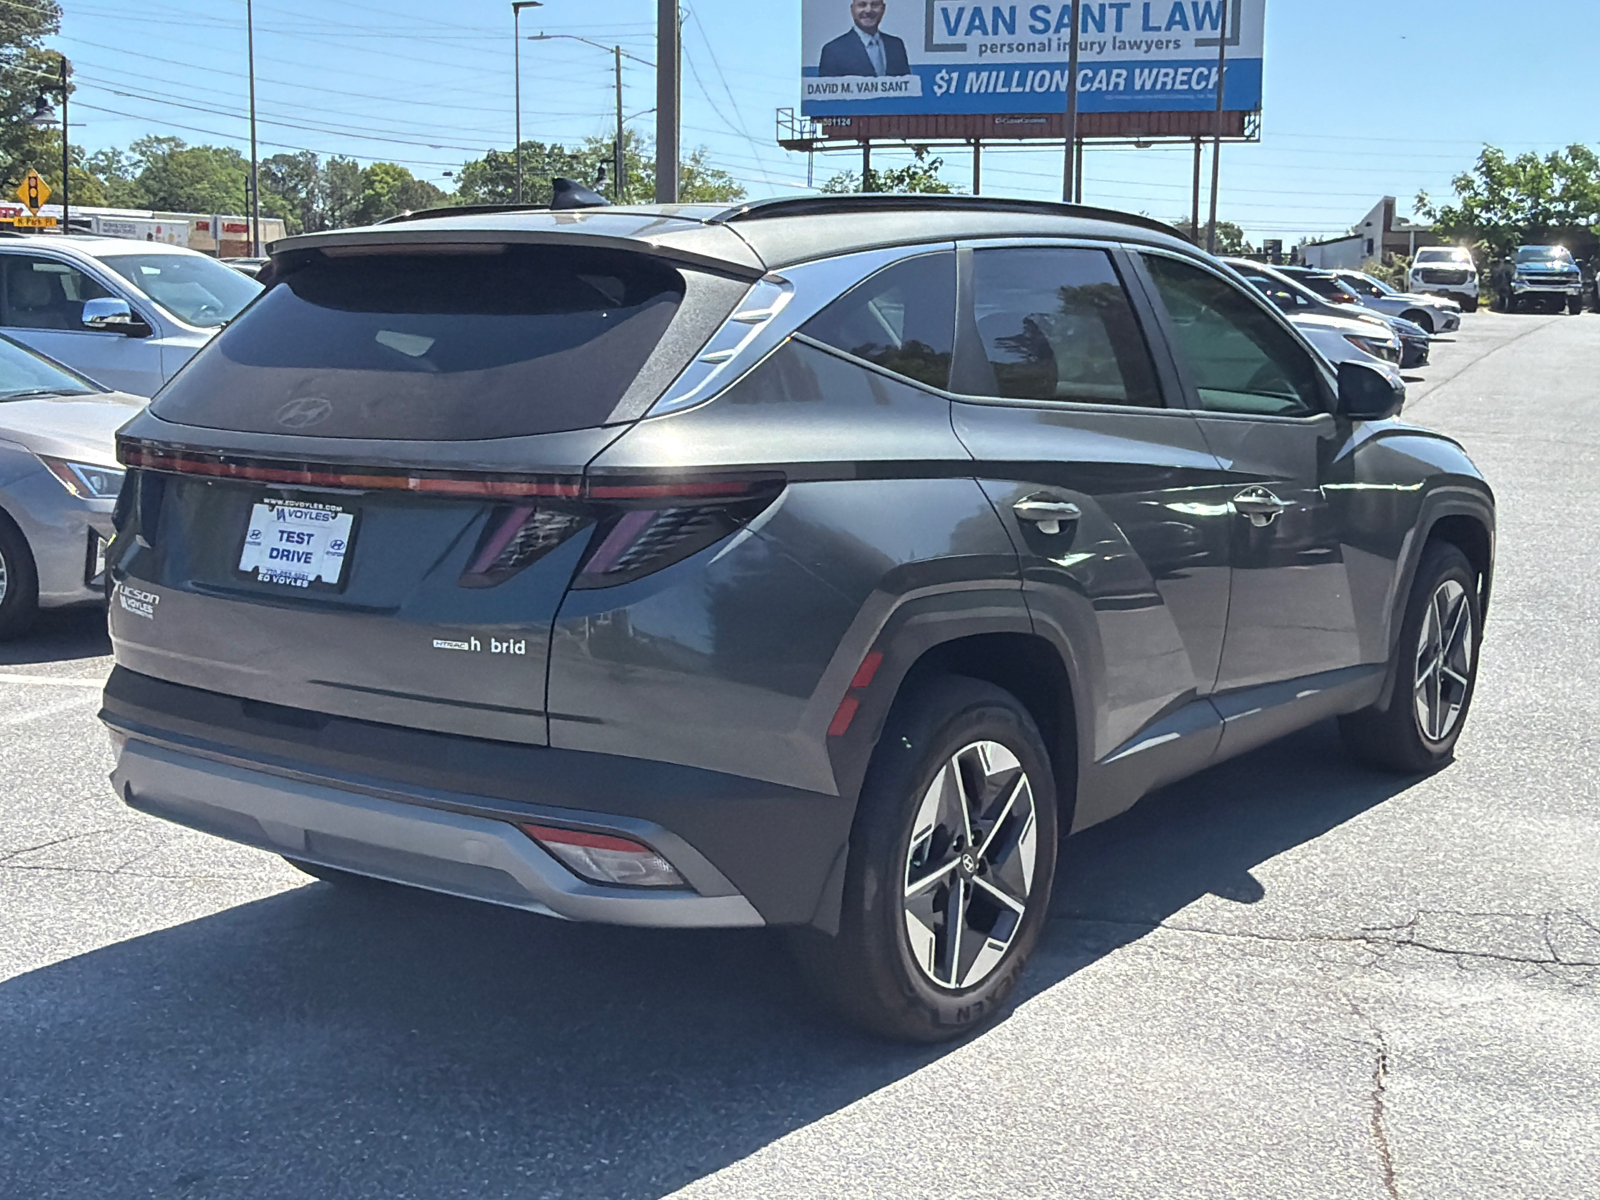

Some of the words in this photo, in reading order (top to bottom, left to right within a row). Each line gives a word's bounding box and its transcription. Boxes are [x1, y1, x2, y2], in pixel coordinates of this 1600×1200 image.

[940, 5, 1017, 37] VAN
[1028, 2, 1131, 35] SANT
[1141, 1, 1224, 32] LAW
[978, 37, 1051, 57] personal
[1057, 36, 1107, 55] inury
[1112, 36, 1181, 54] lawyers
[807, 83, 838, 94] DAVID
[841, 82, 853, 93] M.
[857, 82, 878, 93] VAN
[881, 80, 910, 92] SANT
[932, 68, 959, 97] $1
[964, 69, 1070, 94] MILLION
[1076, 68, 1128, 92] CAR
[26, 217, 42, 226] Park
[288, 509, 330, 522] VOYLES
[278, 529, 315, 546] TEST
[268, 546, 314, 565] DRIVE
[257, 573, 271, 583] ED
[272, 575, 309, 588] VOYLES
